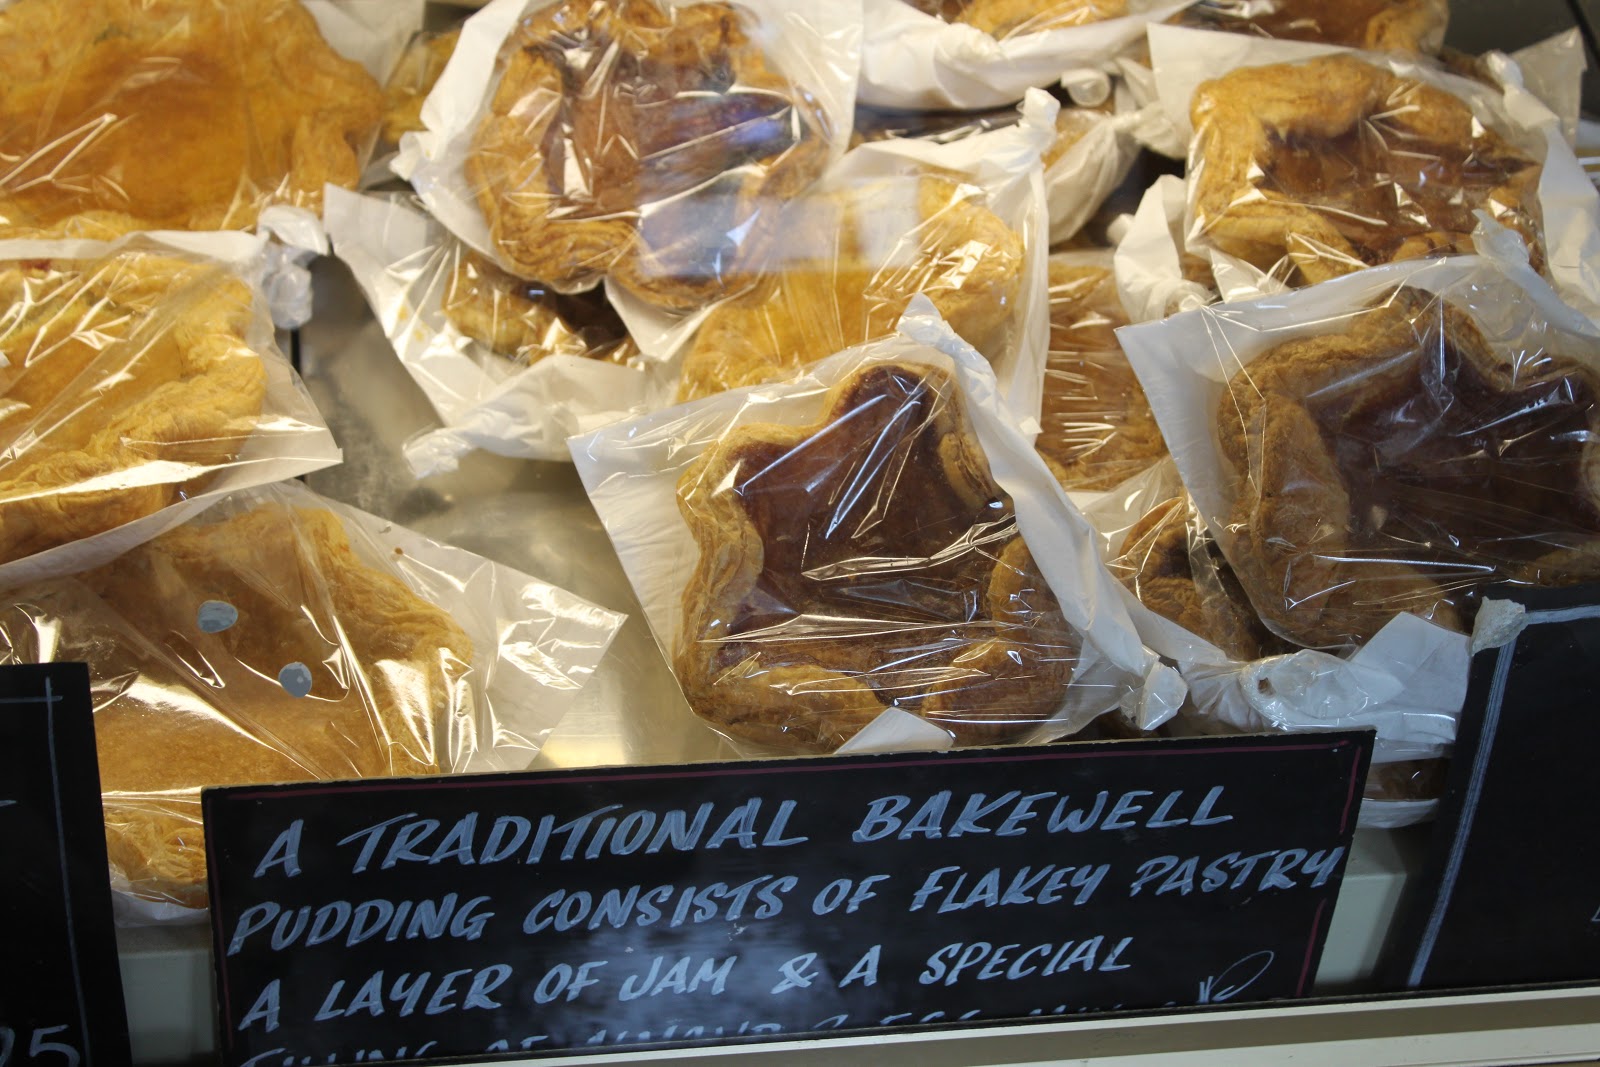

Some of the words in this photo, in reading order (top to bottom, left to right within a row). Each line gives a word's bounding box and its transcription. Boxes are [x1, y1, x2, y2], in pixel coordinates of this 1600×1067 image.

[253, 818, 304, 878] A
[337, 797, 808, 874] TRADITIONAL
[851, 785, 1234, 843] BAKEWELL
[227, 892, 496, 956] PUDDING
[522, 875, 798, 935] CONSISTS
[812, 874, 892, 916] OF
[908, 863, 1111, 914] FLAKEY
[1129, 846, 1345, 897] PASTRY
[238, 978, 281, 1033] A
[314, 963, 514, 1022] LAYER
[534, 960, 609, 1004] OF
[618, 954, 737, 1002] JAM
[770, 951, 820, 996] &
[838, 944, 882, 988] A
[918, 936, 1133, 987] SPECIAL
